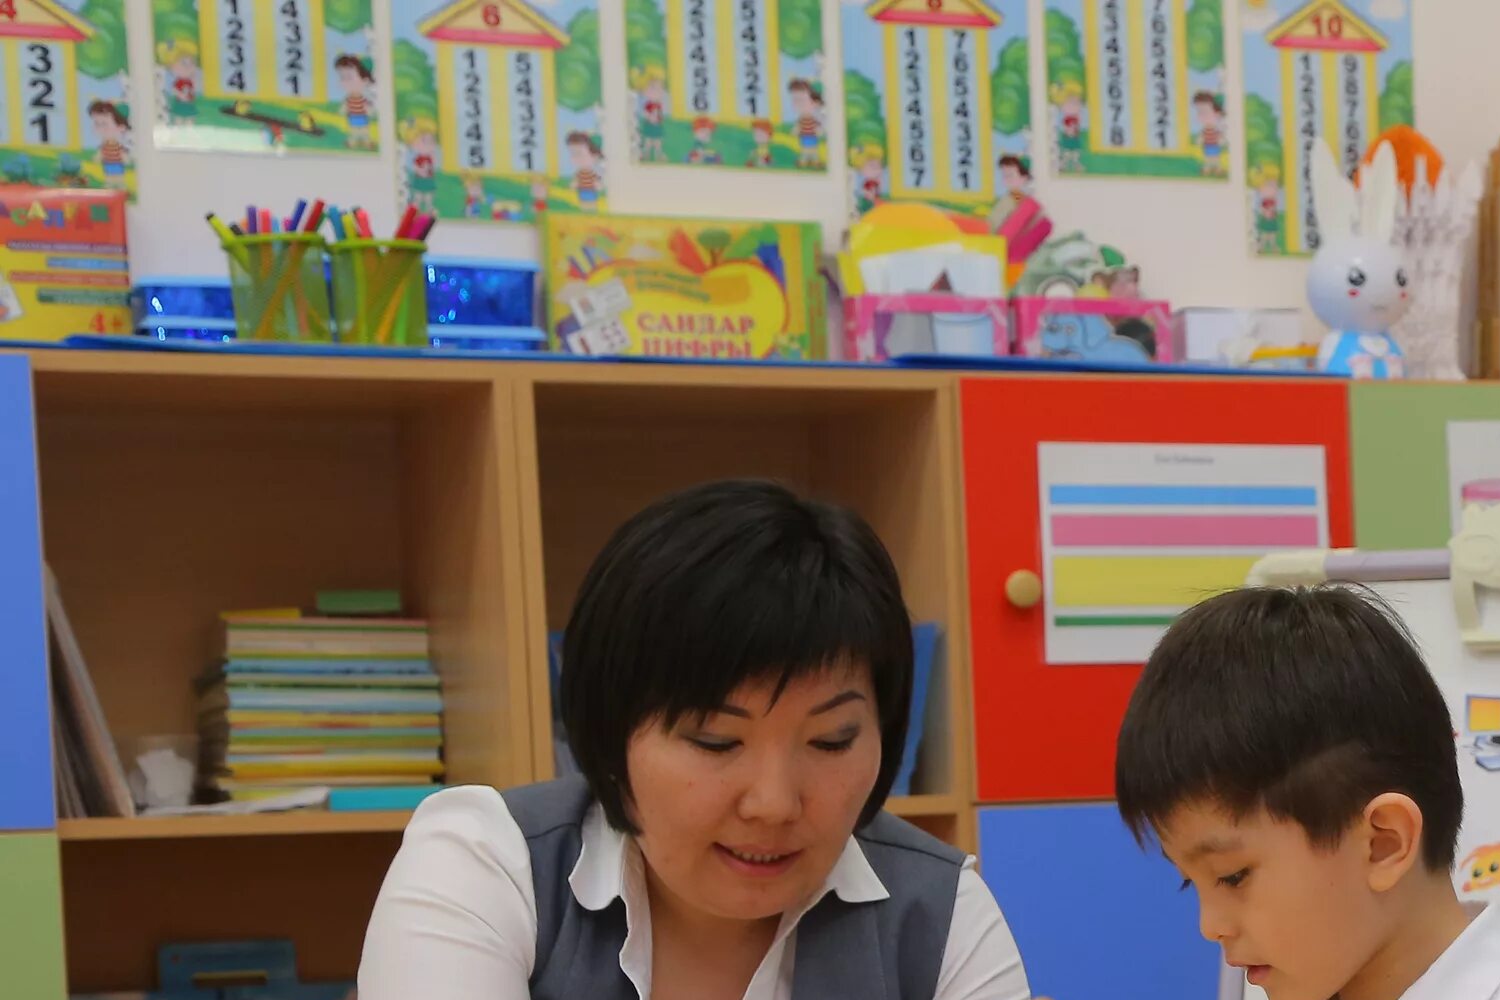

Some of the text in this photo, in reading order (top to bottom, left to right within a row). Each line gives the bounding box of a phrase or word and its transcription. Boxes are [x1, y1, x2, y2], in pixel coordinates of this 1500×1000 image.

[281, 0, 297, 18] 4
[482, 4, 500, 27] 6
[227, 19, 301, 42] 2 3
[1311, 15, 1344, 38] 10
[905, 28, 966, 49] 1 7
[28, 44, 52, 73] 3
[228, 43, 302, 70] 3 2
[463, 50, 531, 73] 1 5
[906, 50, 968, 72] 2 6
[30, 79, 54, 107] 2
[227, 71, 298, 95] 4 1
[465, 72, 531, 96] 2 4
[908, 74, 967, 96] 3 5
[466, 96, 534, 122] 3 3
[907, 99, 968, 118] 4 4
[30, 113, 48, 142] 1
[465, 123, 535, 147] 4 2
[911, 120, 970, 142] 5 3
[470, 146, 532, 170] 5 1
[910, 145, 971, 166] 6 2
[911, 167, 969, 189] 7 1
